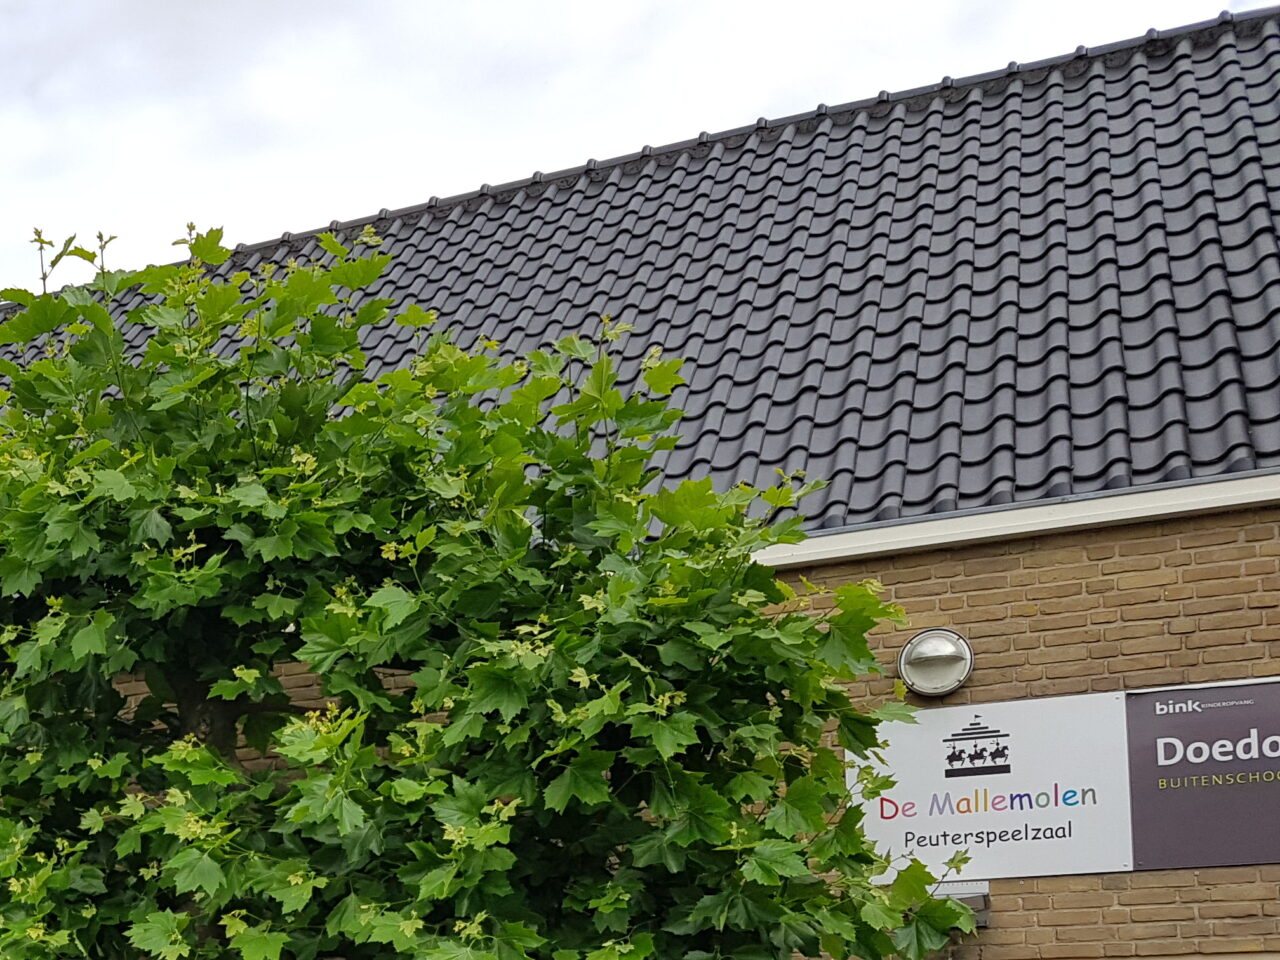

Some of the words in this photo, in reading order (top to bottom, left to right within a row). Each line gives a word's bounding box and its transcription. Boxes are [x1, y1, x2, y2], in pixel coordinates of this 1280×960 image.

[1155, 700, 1202, 715] bink
[1201, 699, 1255, 709] KINDEROPVANG
[1156, 728, 1280, 766] Doedo
[879, 796, 918, 821] De
[928, 783, 1098, 817] Mallemolen
[904, 821, 1073, 849] Peuterspeelzaal
